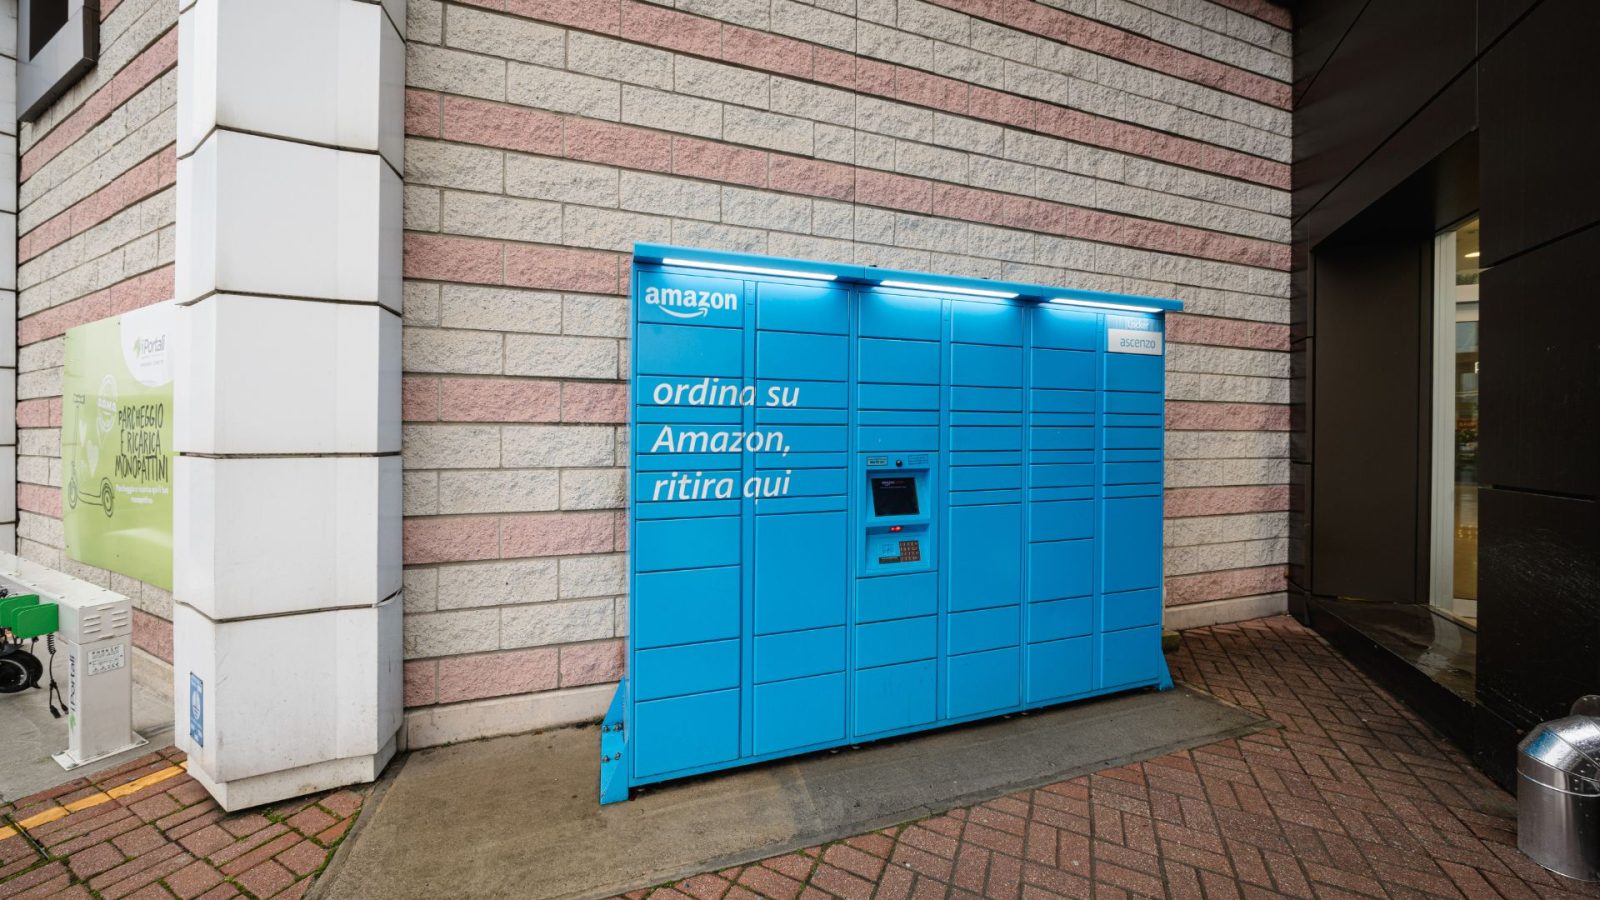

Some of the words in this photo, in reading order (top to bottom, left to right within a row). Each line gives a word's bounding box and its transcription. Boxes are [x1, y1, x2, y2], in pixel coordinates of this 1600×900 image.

[645, 286, 738, 311] amazon
[1120, 337, 1156, 349] ascenzo
[653, 377, 756, 407] ordina
[766, 386, 800, 408] su
[118, 402, 164, 430] PARCHEGGIO
[120, 429, 126, 457] E
[127, 430, 162, 457] RICARICA
[651, 425, 791, 457] Amazon,
[115, 455, 168, 484] MONOPATTINI
[653, 471, 734, 502] ritira
[743, 469, 792, 505] qui
